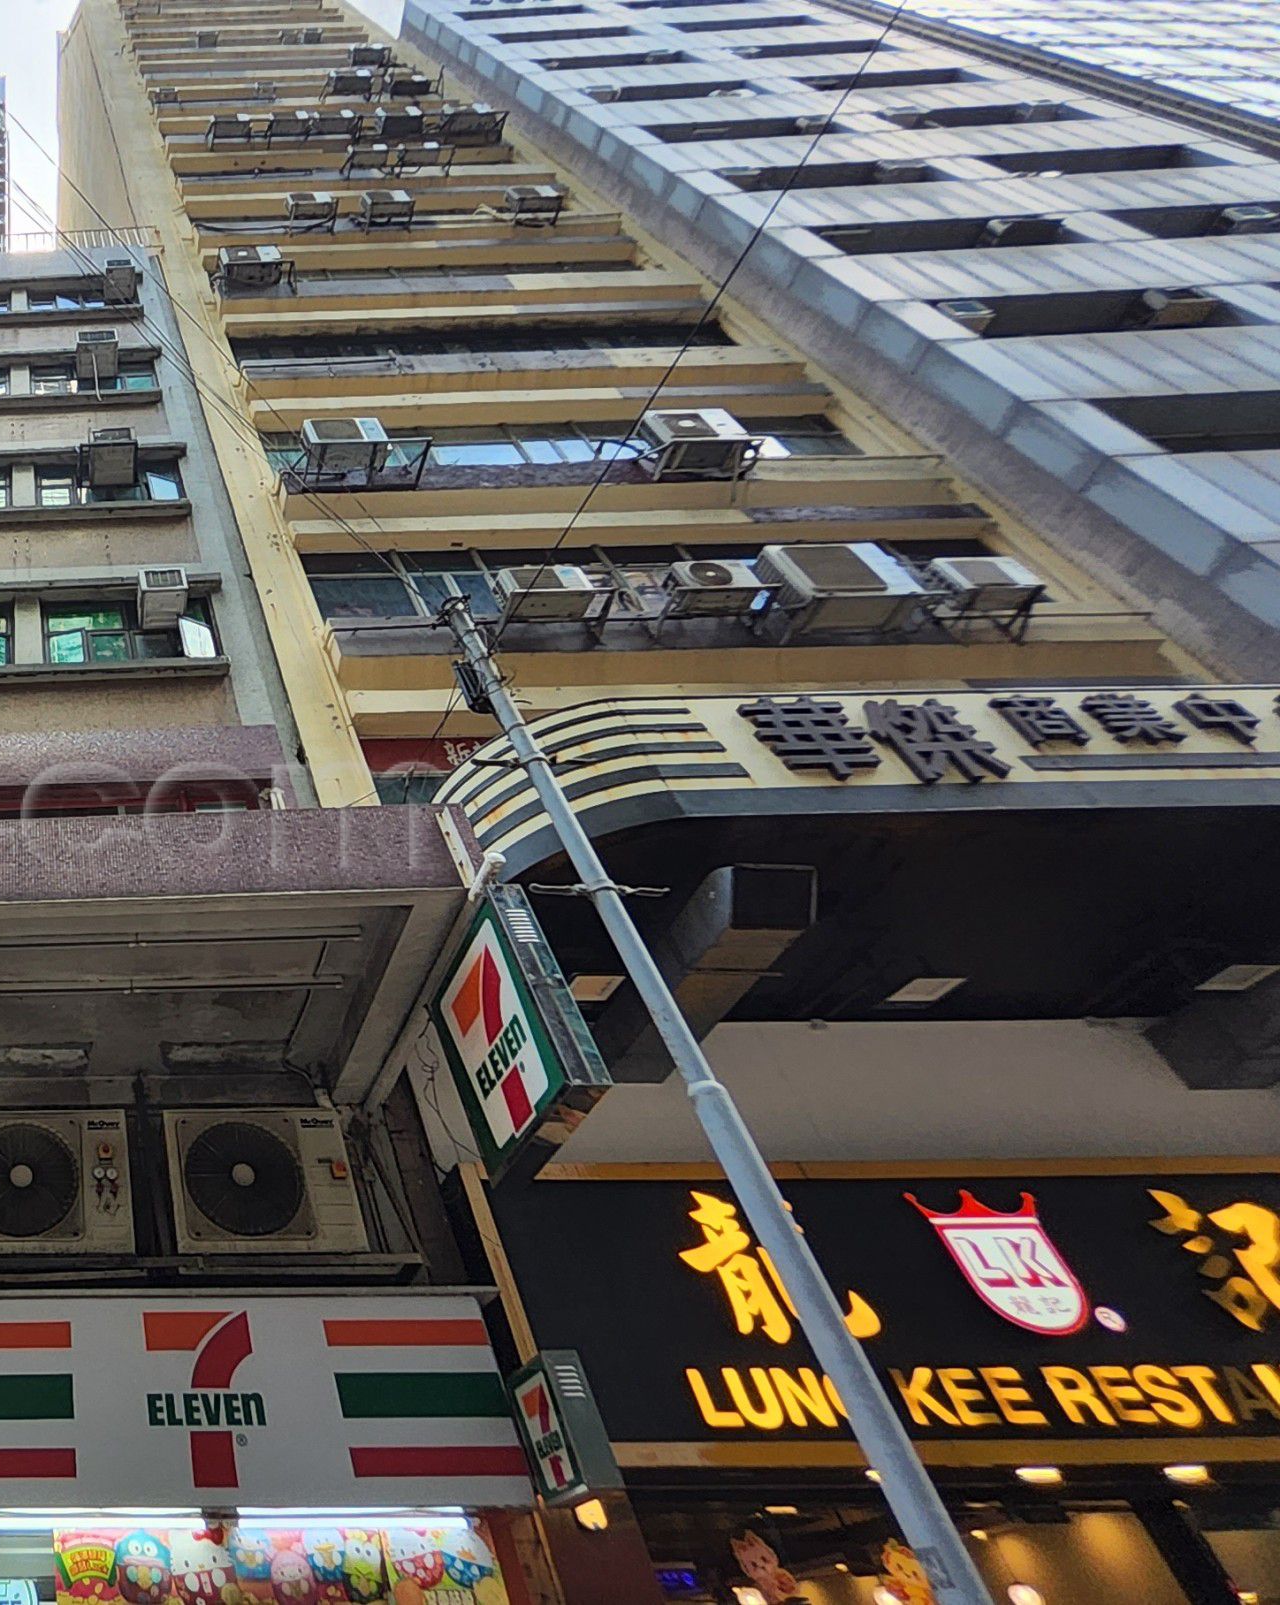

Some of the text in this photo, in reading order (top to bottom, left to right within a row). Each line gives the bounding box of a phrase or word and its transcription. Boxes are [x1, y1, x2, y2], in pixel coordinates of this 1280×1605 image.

[737, 694, 1280, 784] 華傑商業中
[950, 1236, 1071, 1288] LK
[142, 1310, 253, 1488] 7
[888, 1366, 1051, 1426] KEE
